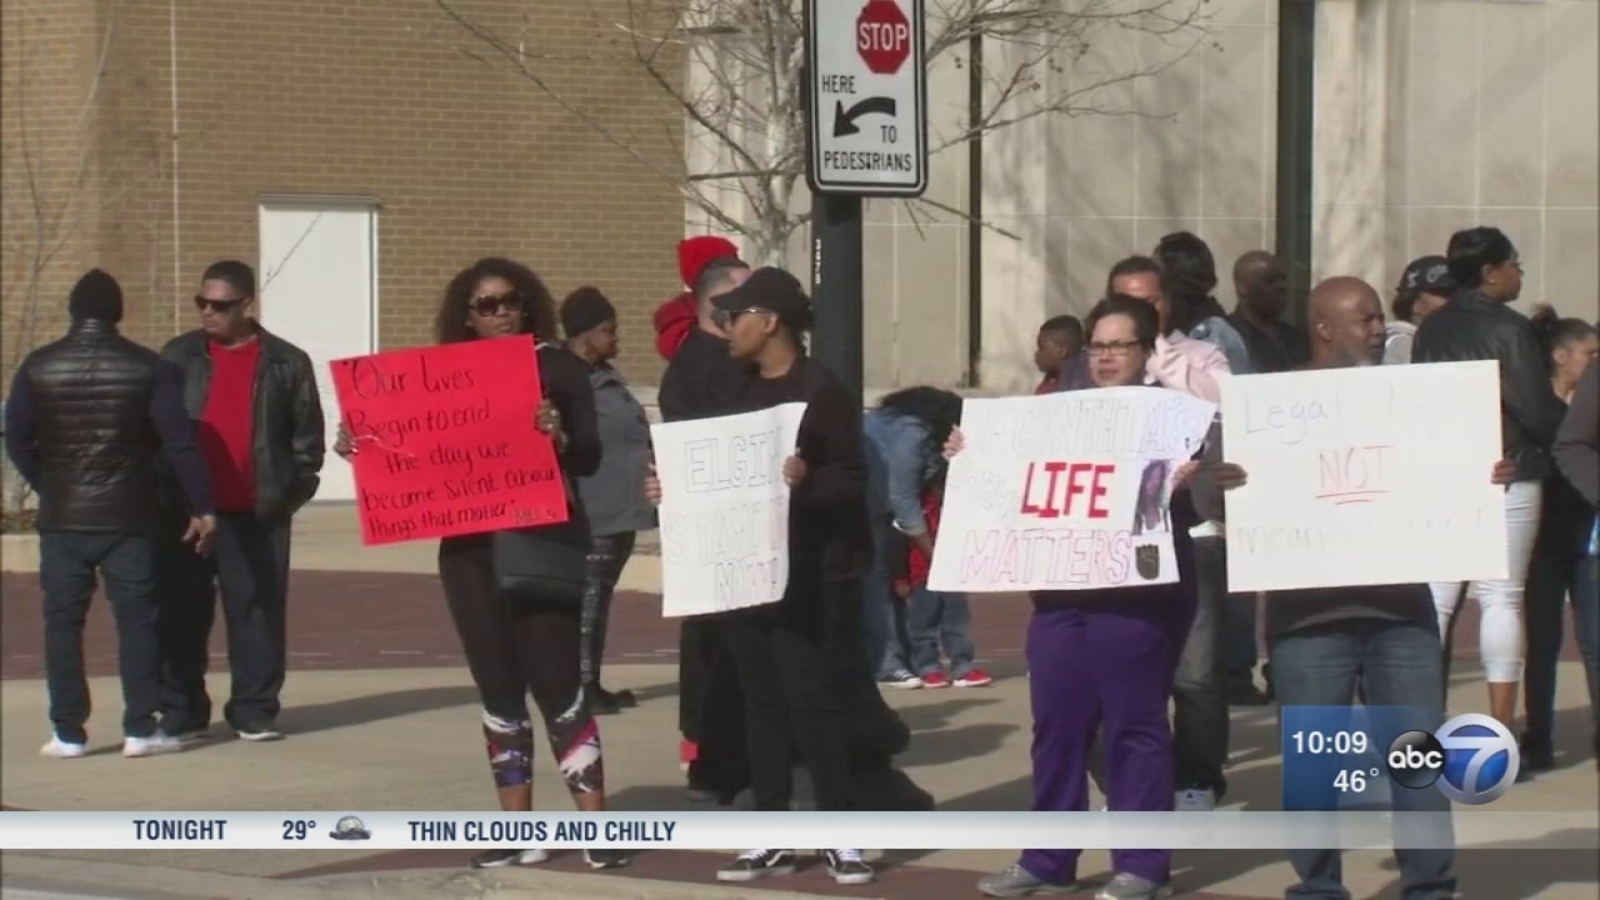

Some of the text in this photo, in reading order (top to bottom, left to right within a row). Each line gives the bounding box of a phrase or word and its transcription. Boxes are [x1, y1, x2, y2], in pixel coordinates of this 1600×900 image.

[859, 22, 908, 51] STOP
[821, 75, 856, 94] HERE
[880, 125, 898, 143] TO
[824, 151, 912, 172] PEDESTRIANS
[346, 397, 491, 449] Begin to end
[1245, 391, 1341, 445] Legal
[385, 441, 509, 476] the day we
[1319, 445, 1395, 490] NOT
[362, 487, 436, 512] become
[1020, 462, 1115, 518] LIFE
[420, 504, 455, 531] that
[960, 528, 1133, 585] MATTERS
